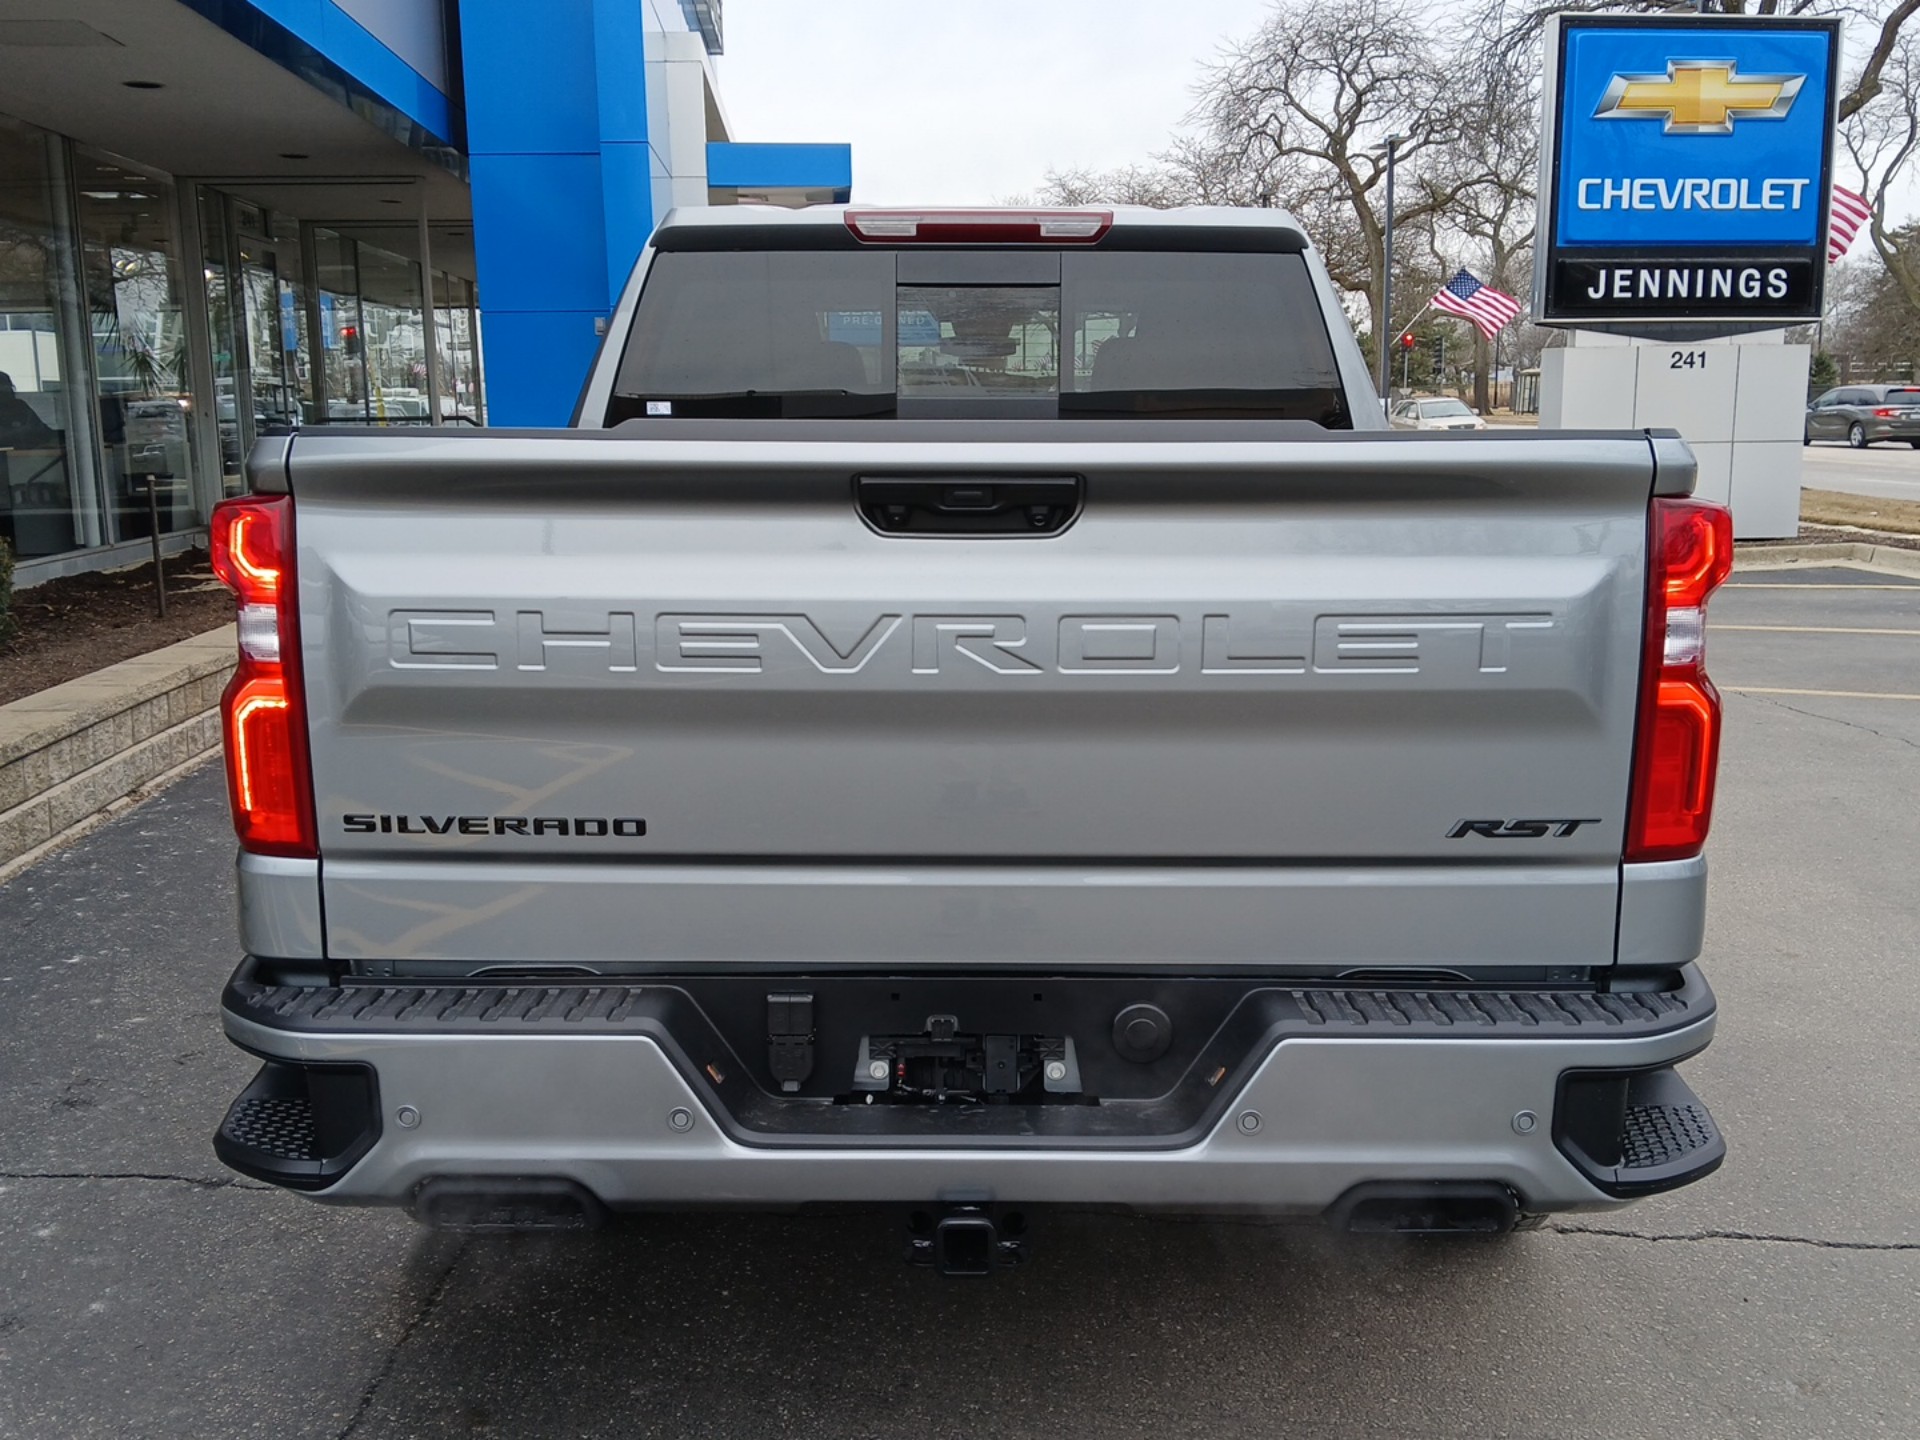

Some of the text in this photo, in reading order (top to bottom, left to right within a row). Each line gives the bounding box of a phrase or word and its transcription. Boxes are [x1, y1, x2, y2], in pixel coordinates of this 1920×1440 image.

[1578, 178, 1810, 210] CHEVROLET
[1587, 267, 1789, 300] JENNINGS
[843, 316, 925, 325] PRE-ONED
[1670, 351, 1706, 369] 241
[388, 607, 1555, 675] CHEVROLET
[343, 813, 648, 838] SILVERADO
[1444, 817, 1602, 839] RST
